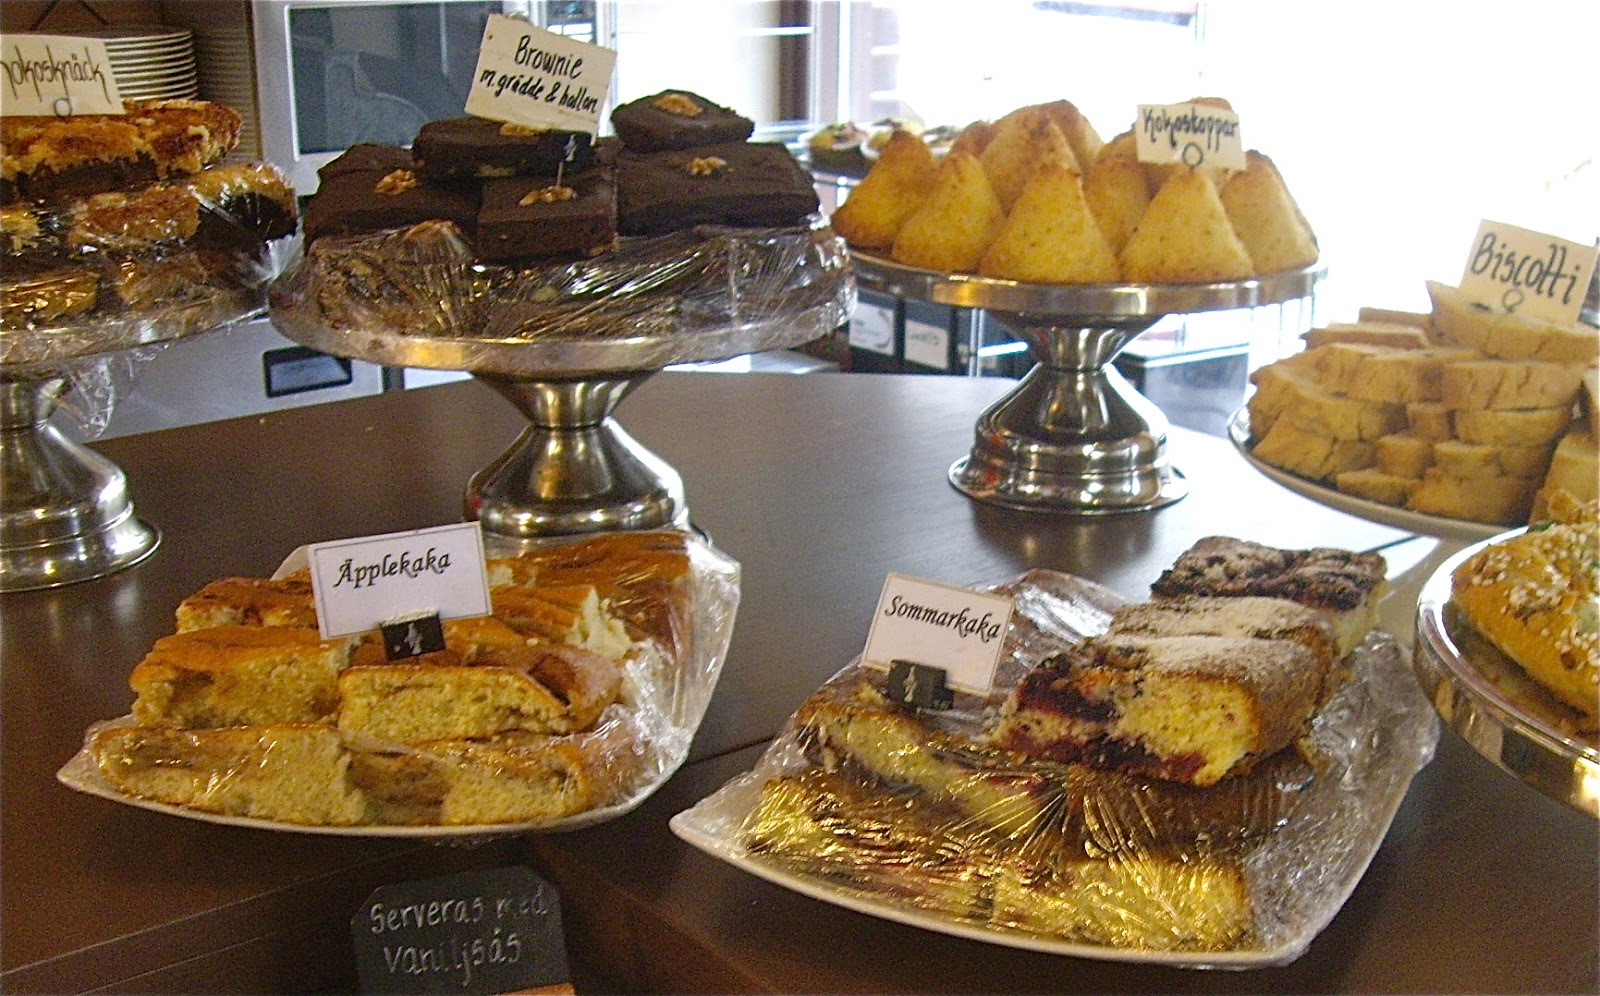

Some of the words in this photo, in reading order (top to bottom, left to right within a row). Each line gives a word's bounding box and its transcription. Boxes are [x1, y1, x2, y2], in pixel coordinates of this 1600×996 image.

[514, 34, 584, 80] Brownie
[479, 68, 496, 88] m.
[544, 81, 561, 103] &
[1142, 106, 1239, 152] Kokostoppar
[1471, 232, 1580, 305] Biscotti
[332, 547, 452, 589] Äpplekaka
[884, 594, 1002, 644] Sommarkaka
[369, 896, 484, 934] Serveras
